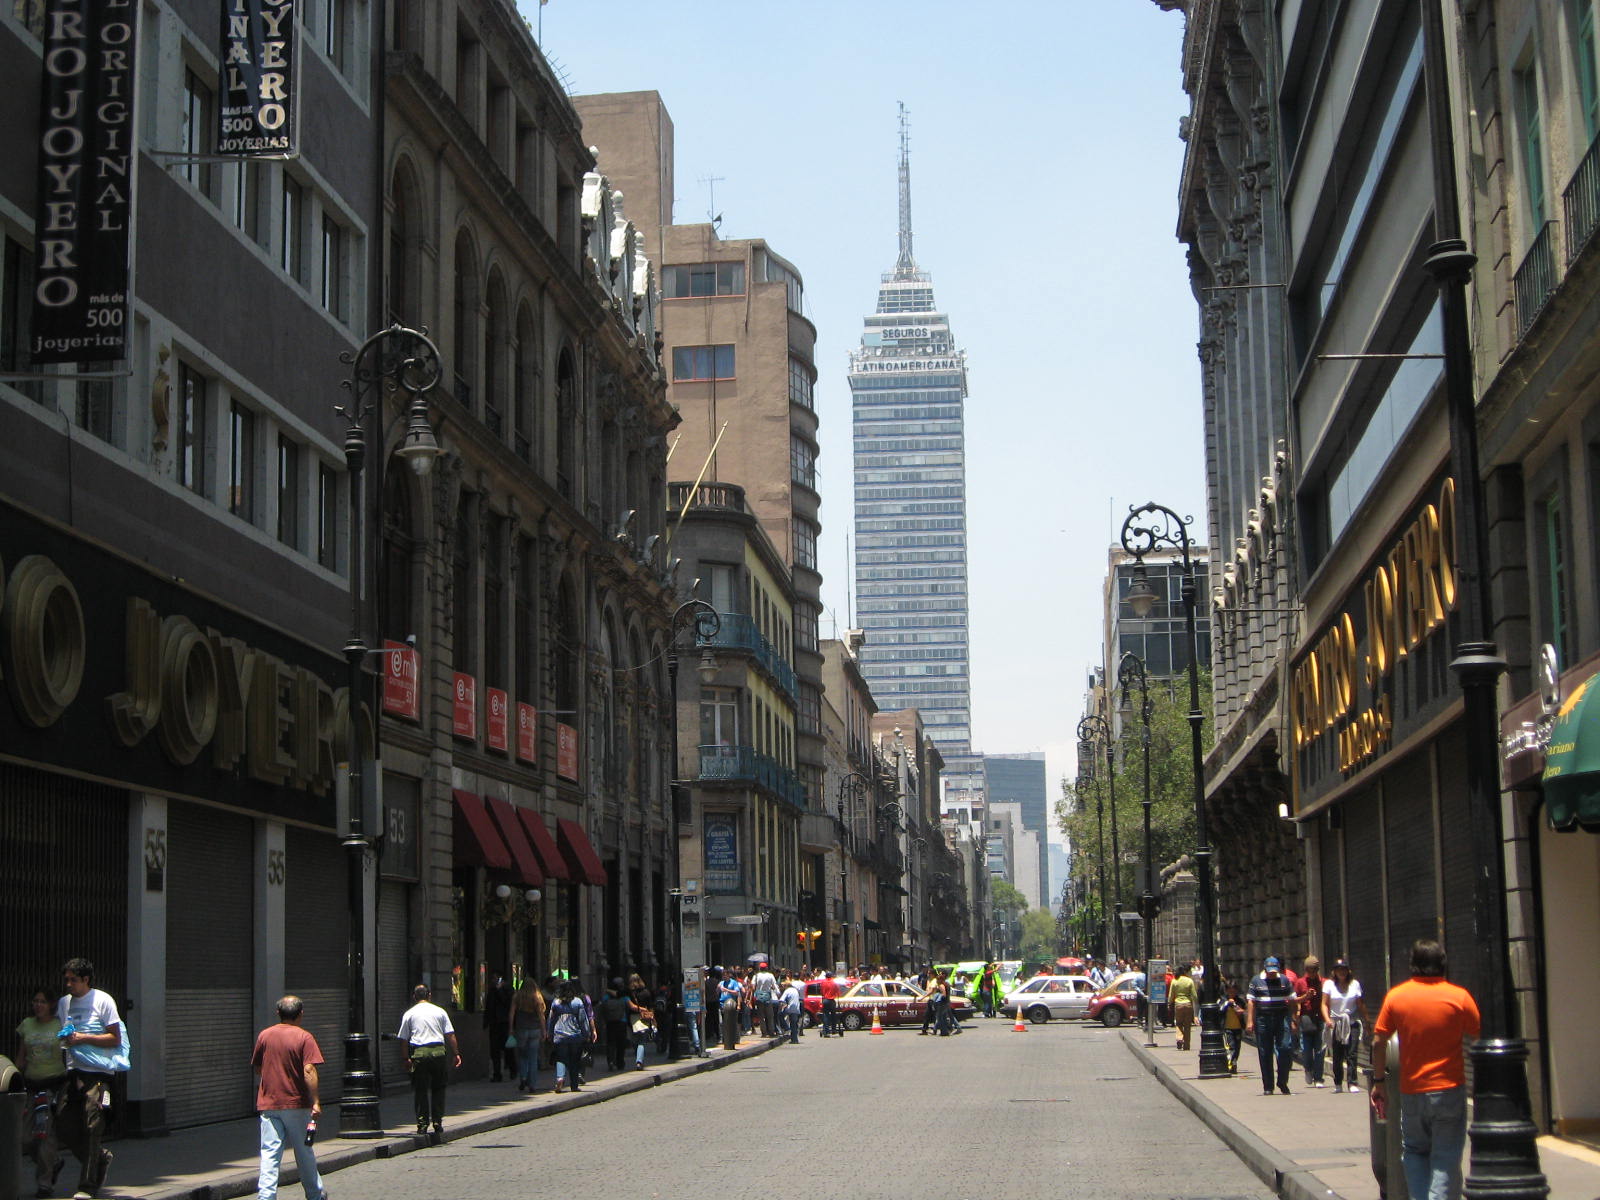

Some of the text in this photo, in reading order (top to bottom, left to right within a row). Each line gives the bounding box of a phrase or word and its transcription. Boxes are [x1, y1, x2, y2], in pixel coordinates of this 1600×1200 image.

[258, 0, 292, 130] YERO
[97, 22, 132, 231] ORIGINAL
[222, 118, 253, 132] 500
[37, 0, 87, 306] RO JOYERO
[219, 136, 289, 151] JOYERIAS
[111, 291, 125, 303] de
[86, 308, 123, 328] 500
[882, 327, 928, 339] SEGUROS
[33, 333, 125, 354] joyerias
[856, 360, 955, 373] LATINOAMERICANA
[1363, 476, 1459, 690] JOYERO
[267, 849, 286, 886] 55
[897, 1009, 919, 1017] TAXI
